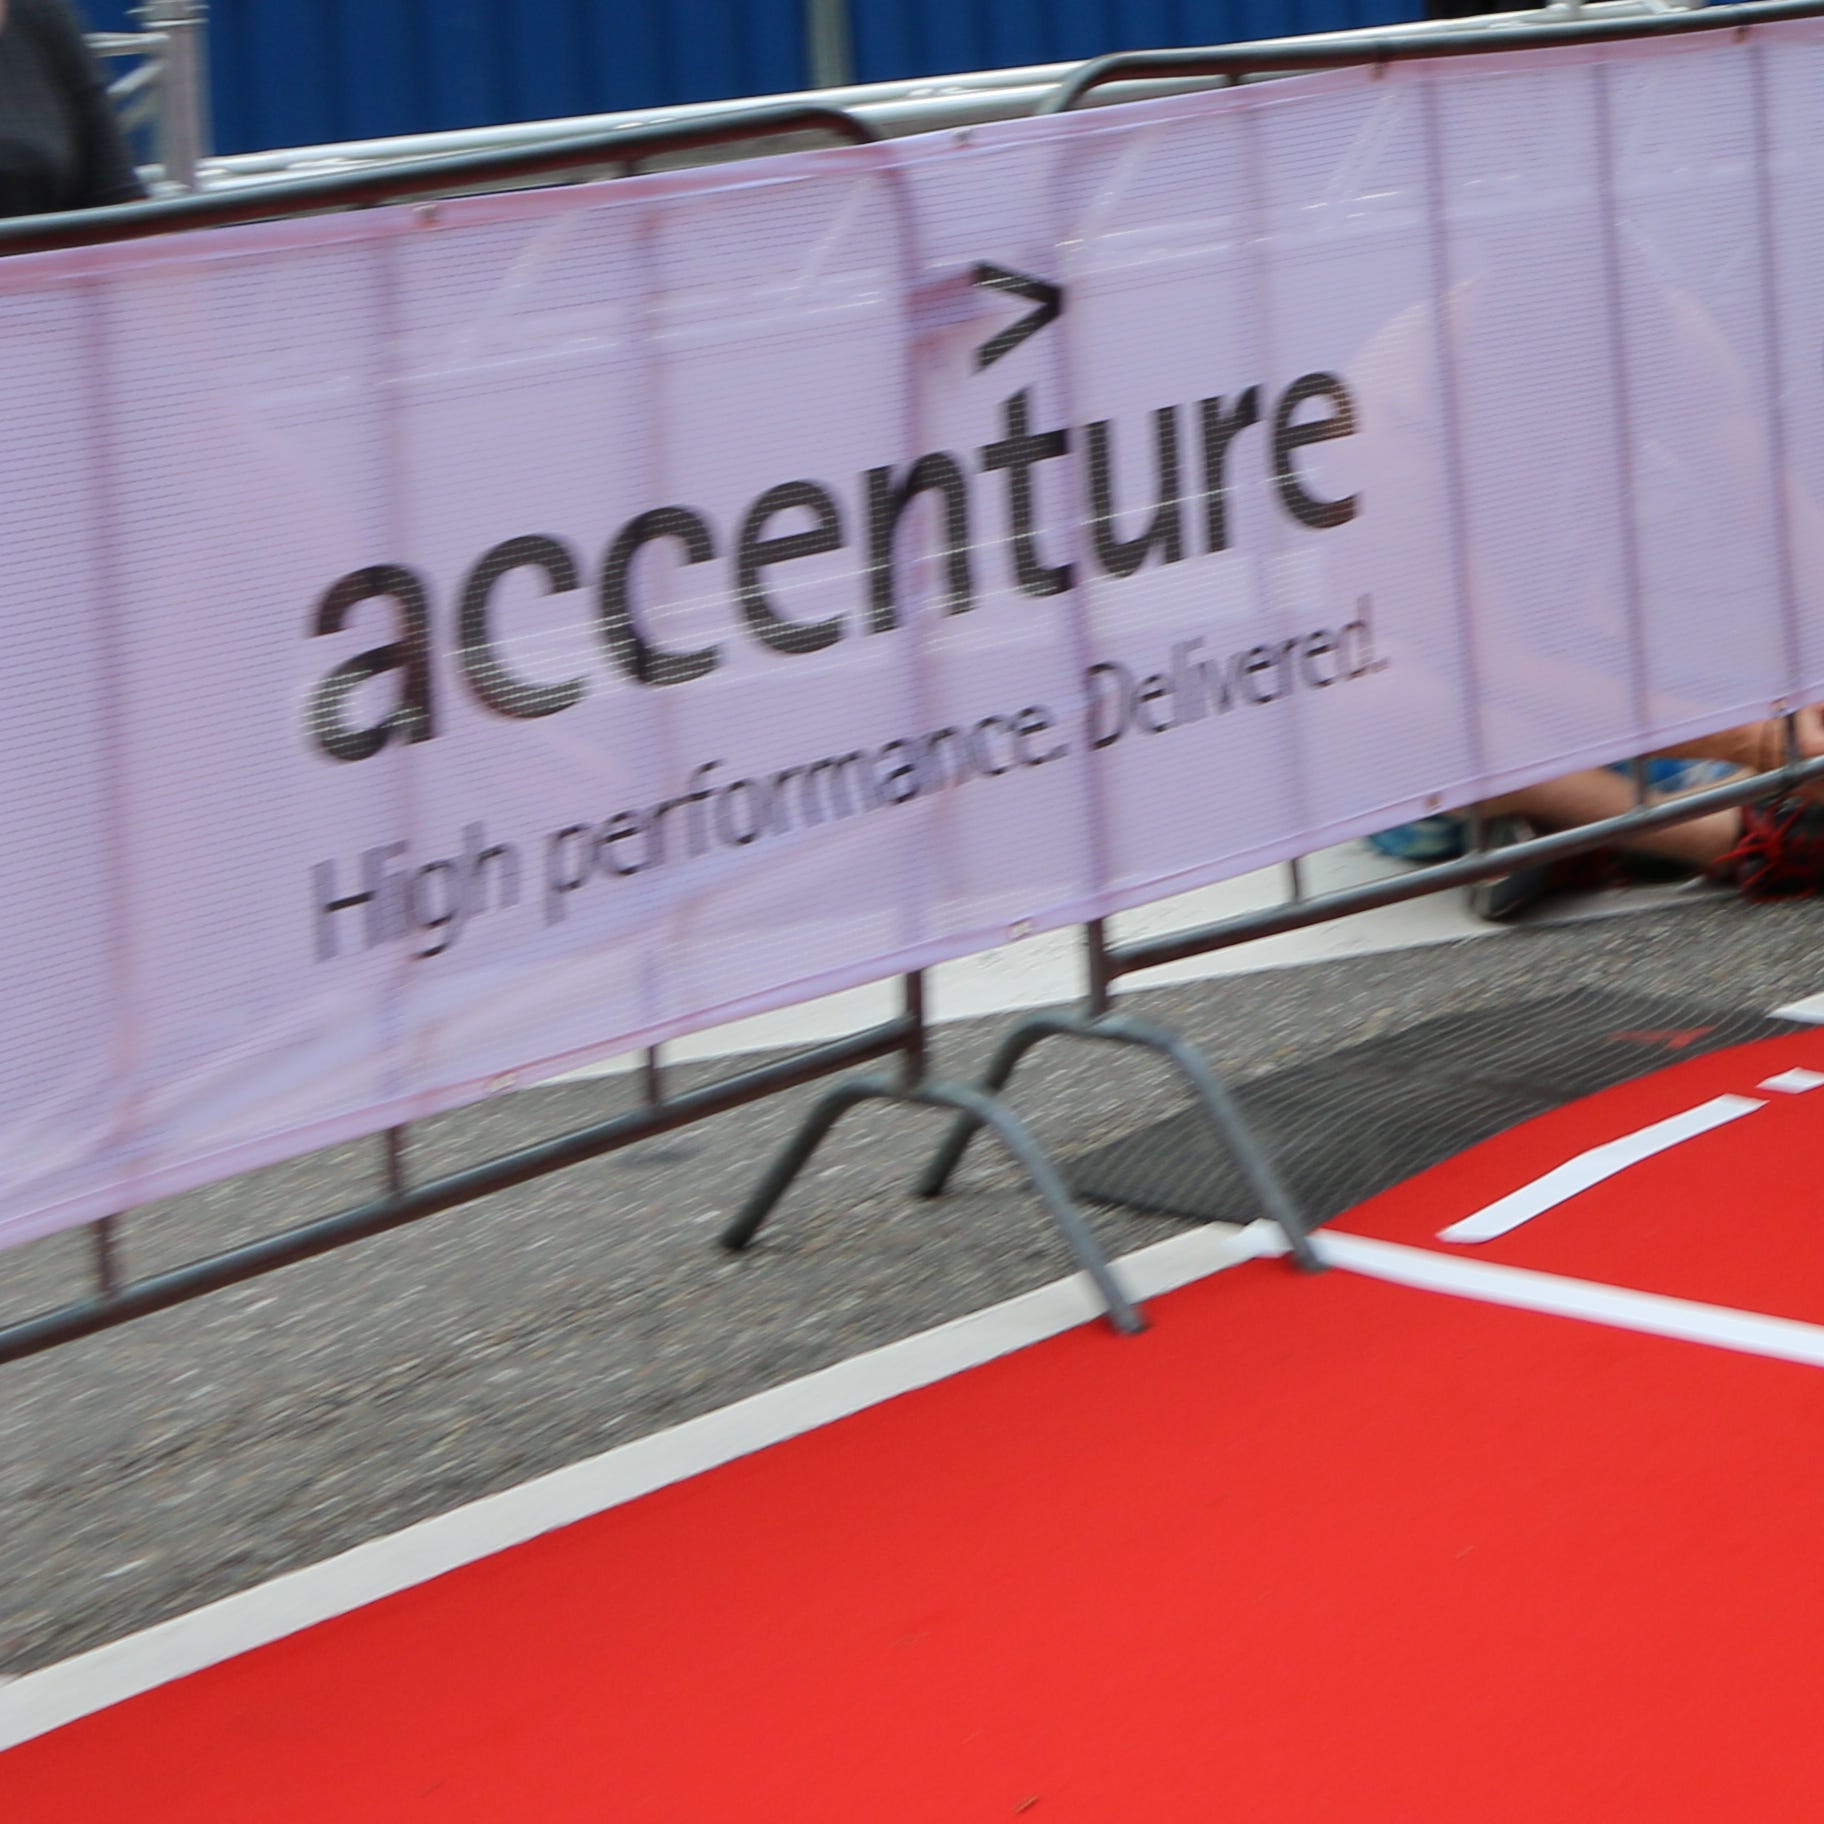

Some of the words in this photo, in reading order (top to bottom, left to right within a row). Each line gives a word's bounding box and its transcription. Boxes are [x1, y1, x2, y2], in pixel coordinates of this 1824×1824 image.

[304, 370, 1362, 763] accenture
[312, 821, 520, 962] High
[1083, 593, 1391, 752] Delivered.
